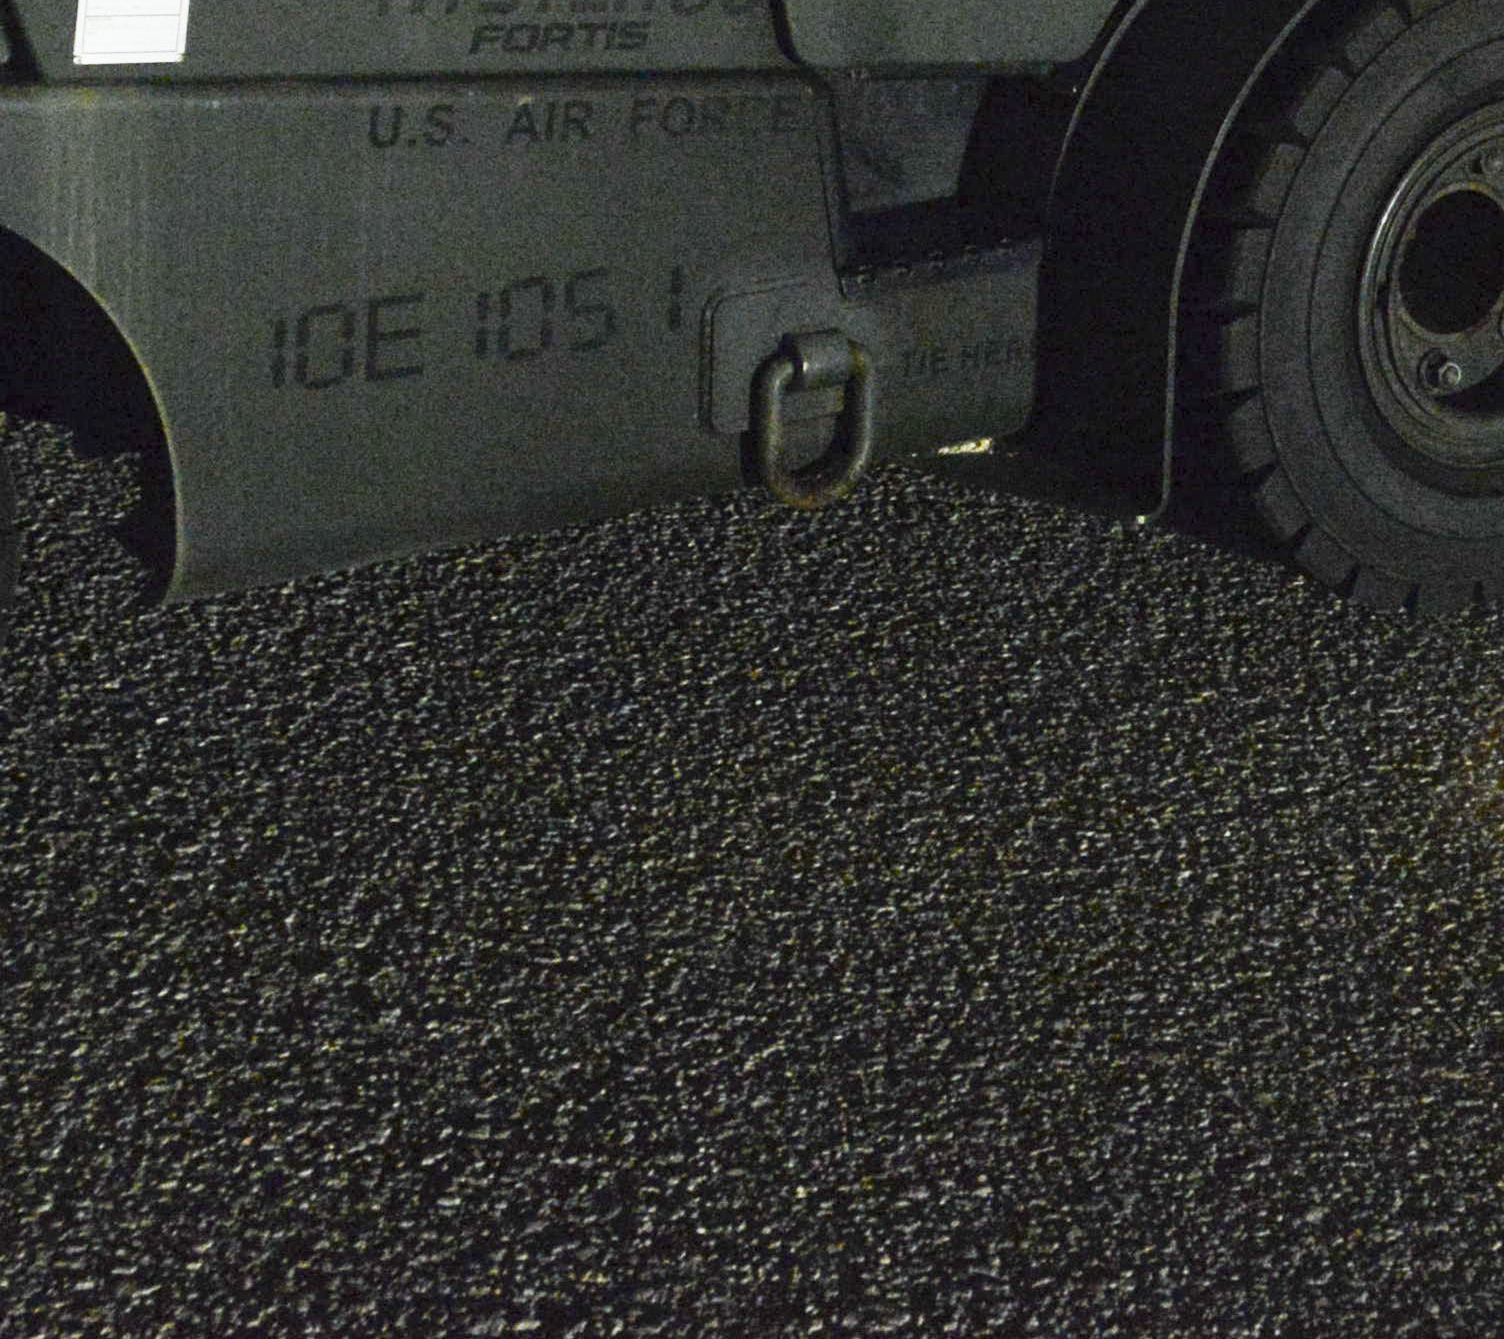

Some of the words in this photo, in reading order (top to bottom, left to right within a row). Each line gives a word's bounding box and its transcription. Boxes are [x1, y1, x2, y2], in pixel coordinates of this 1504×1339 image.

[468, 20, 651, 55] FORTIS
[367, 103, 472, 150] U.S.
[504, 99, 597, 146] AIR
